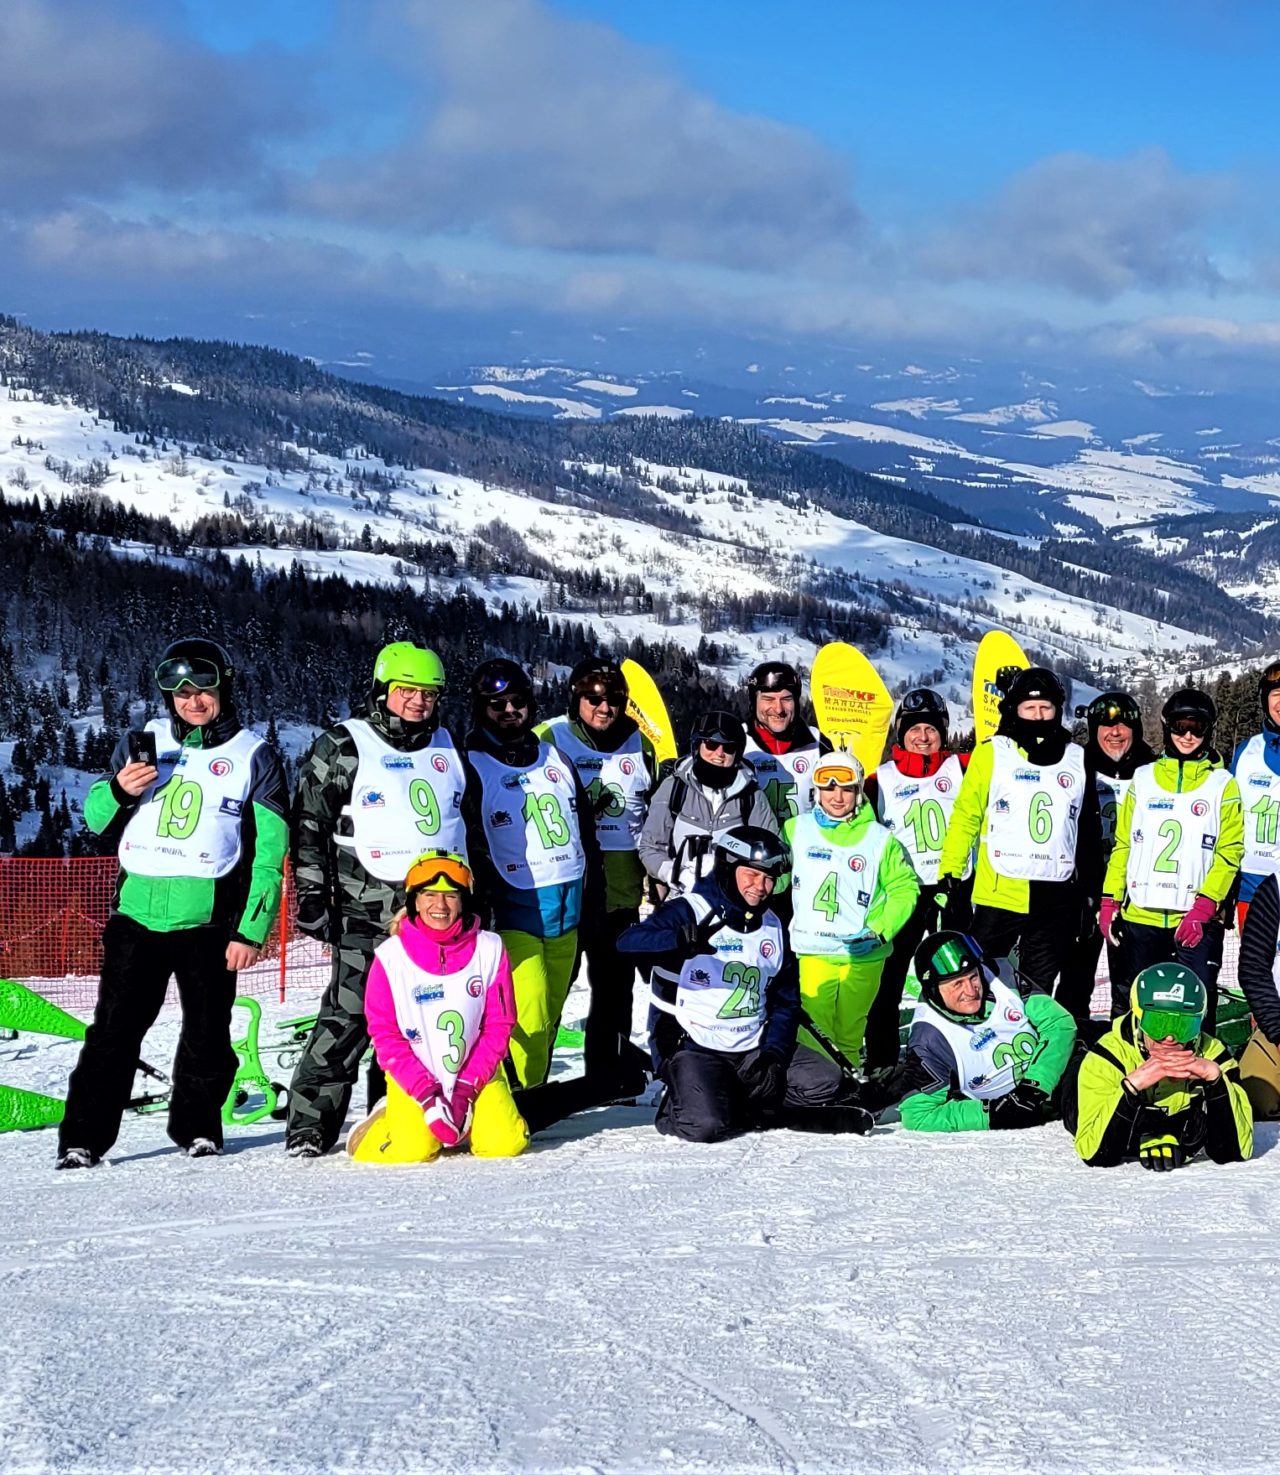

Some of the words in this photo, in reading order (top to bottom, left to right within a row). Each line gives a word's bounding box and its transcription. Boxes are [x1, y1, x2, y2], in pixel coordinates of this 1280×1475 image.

[152, 774, 203, 839] 19
[409, 778, 441, 836] 9
[521, 792, 570, 849] 13
[763, 778, 798, 820] 15
[904, 798, 947, 853] 10
[1028, 791, 1053, 844] 6
[1251, 795, 1280, 844] 11
[1153, 819, 1182, 873] 2
[813, 871, 839, 922] 4
[716, 961, 760, 1019] 23
[437, 1010, 466, 1074] 3
